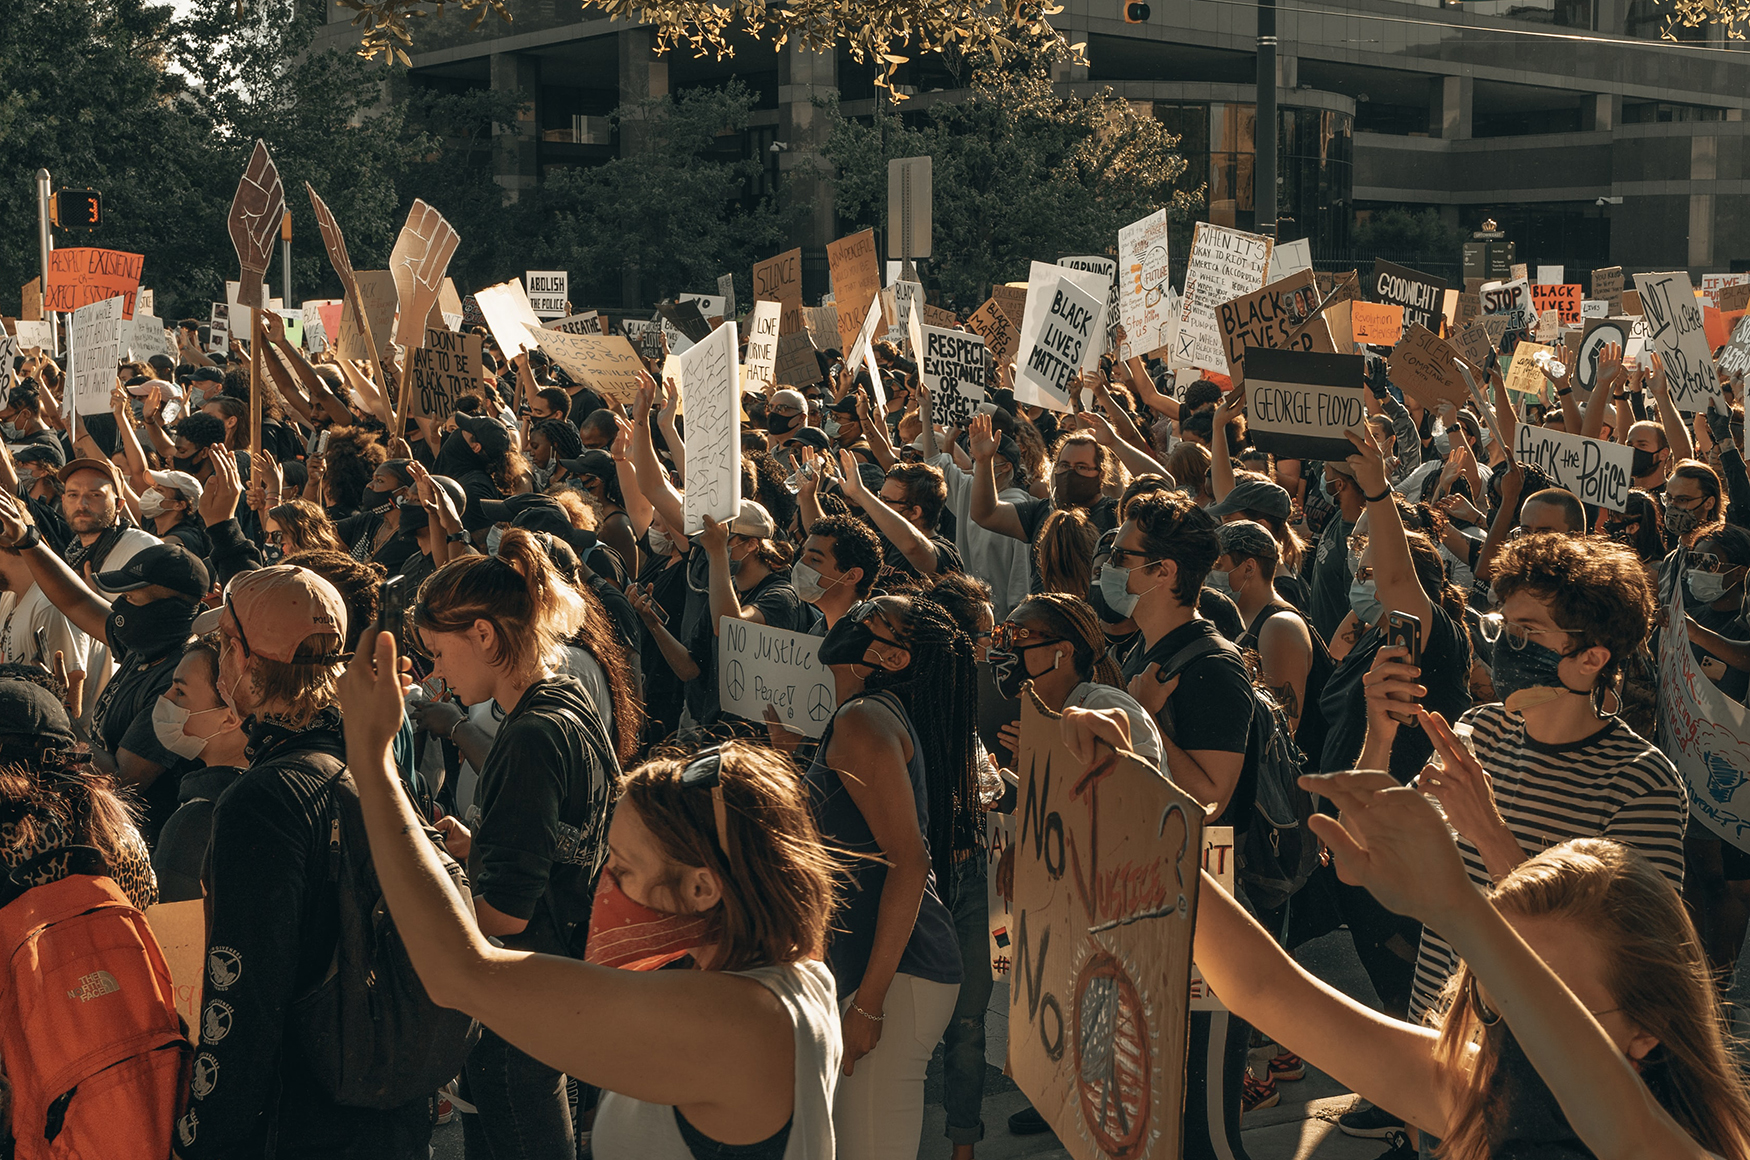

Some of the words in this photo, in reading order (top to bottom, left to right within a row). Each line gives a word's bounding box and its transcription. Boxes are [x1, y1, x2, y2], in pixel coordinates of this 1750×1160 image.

[88, 197, 99, 223] 3
[1199, 228, 1232, 250] WHEN
[1233, 236, 1265, 260] IT'S
[51, 250, 86, 273] RESPECT
[88, 250, 144, 281] EXISTENCE
[1190, 258, 1220, 272] AMERICA
[1193, 245, 1211, 258] OKAY
[1215, 249, 1224, 259] TO
[1225, 252, 1247, 268] RIOT
[1251, 261, 1264, 273] IN
[530, 276, 565, 292] ABOLISH
[1200, 270, 1226, 286] WHITE
[1703, 278, 1720, 290] IF
[530, 298, 541, 310] THE
[541, 298, 564, 310] POLICE
[1377, 272, 1440, 312] GOODNIGHT
[1483, 286, 1523, 314] STOP
[1532, 285, 1575, 298] BLACK
[562, 316, 602, 334] BREATHE
[986, 302, 1011, 328] BLACK
[1050, 289, 1093, 338] BLACK
[1221, 291, 1286, 335] BLACK
[1354, 312, 1393, 325] Revolution
[757, 316, 777, 337] LOVE
[970, 314, 1008, 359] MATTER
[989, 321, 1012, 346] LIVES
[1455, 326, 1484, 349] NEED
[529, 327, 612, 355] ADDRESS
[747, 341, 772, 361] DRIVE
[928, 332, 985, 366] RESPECT
[1043, 323, 1082, 365] LIVES
[1229, 317, 1290, 364] LIVES
[1464, 346, 1478, 360] DO
[436, 350, 450, 373] TO
[454, 354, 470, 374] BE
[746, 364, 770, 381] HATE
[924, 357, 984, 388] EXISTANCE
[1027, 344, 1077, 394] MATTER
[1402, 351, 1454, 387] COMPLIANCE
[1719, 345, 1750, 376] BETRA
[413, 368, 446, 393] BLACK
[447, 374, 461, 396] TO
[940, 377, 961, 397] OR
[1415, 369, 1428, 381] WITH
[421, 387, 457, 419] OUTRA
[1254, 387, 1313, 425] GEORGE
[1318, 393, 1362, 427] FLOYD
[1560, 449, 1580, 469] the
[1576, 440, 1627, 508] Police
[313, 616, 334, 624] POLO
[727, 623, 747, 653] NO
[754, 631, 812, 670] Justice
[754, 675, 796, 719] Peace!
[66, 979, 104, 1000] NORTH
[78, 971, 100, 985] THE
[79, 987, 106, 1003] FACE
